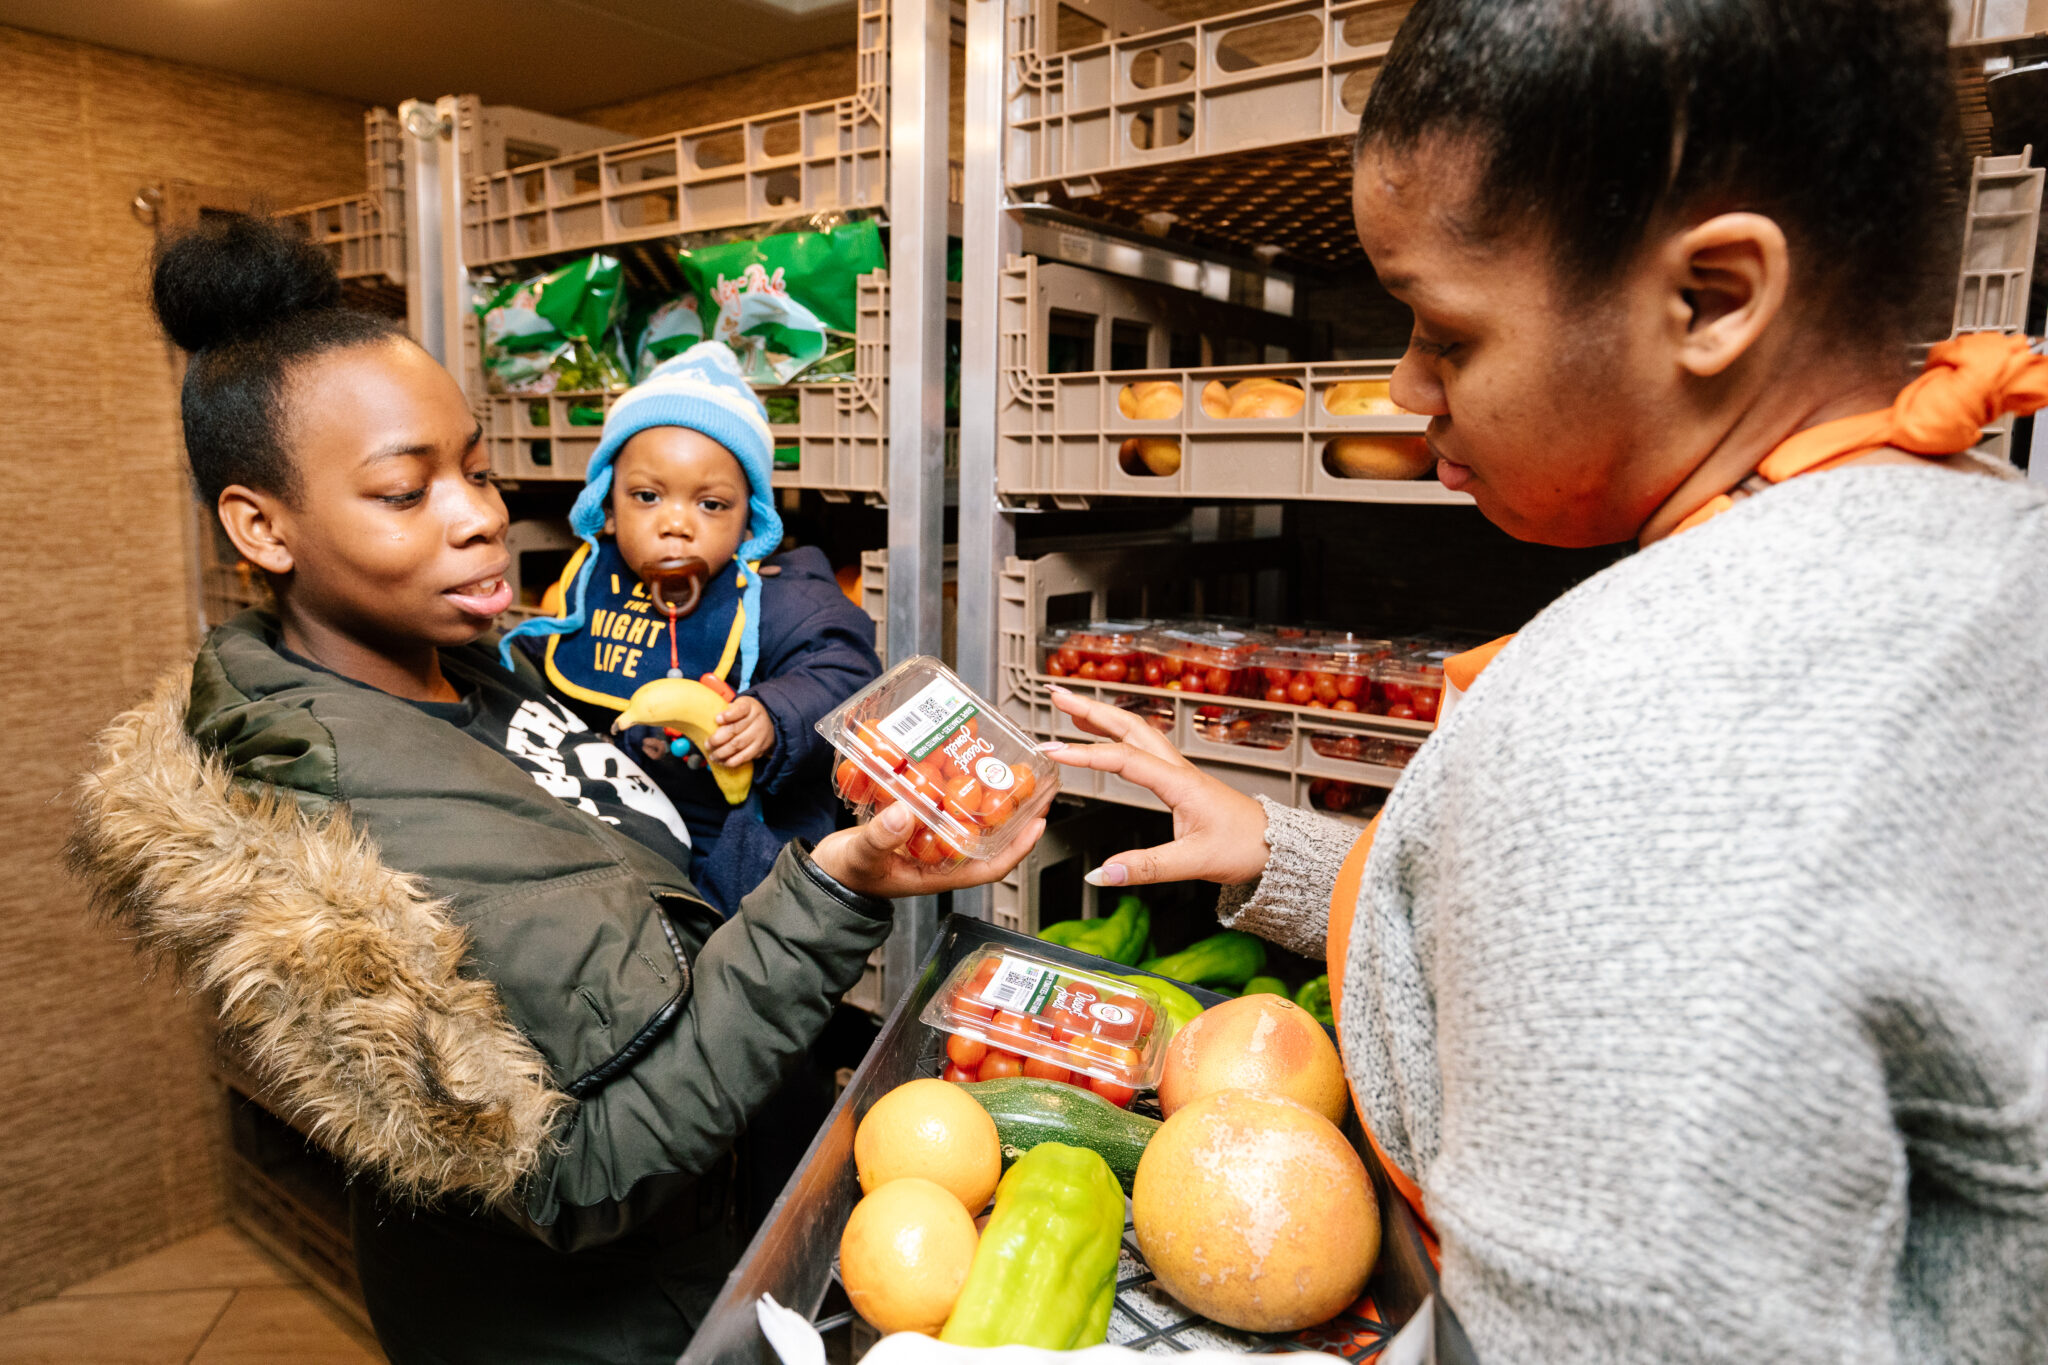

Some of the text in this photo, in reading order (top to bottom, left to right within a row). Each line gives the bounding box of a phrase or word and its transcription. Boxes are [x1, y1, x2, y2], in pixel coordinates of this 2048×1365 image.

[611, 573, 620, 594] I
[623, 600, 652, 613] THE
[590, 608, 666, 648] NIGHT
[594, 641, 643, 678] LIFE
[943, 725, 975, 760] Jewels
[954, 738, 994, 774] Desert
